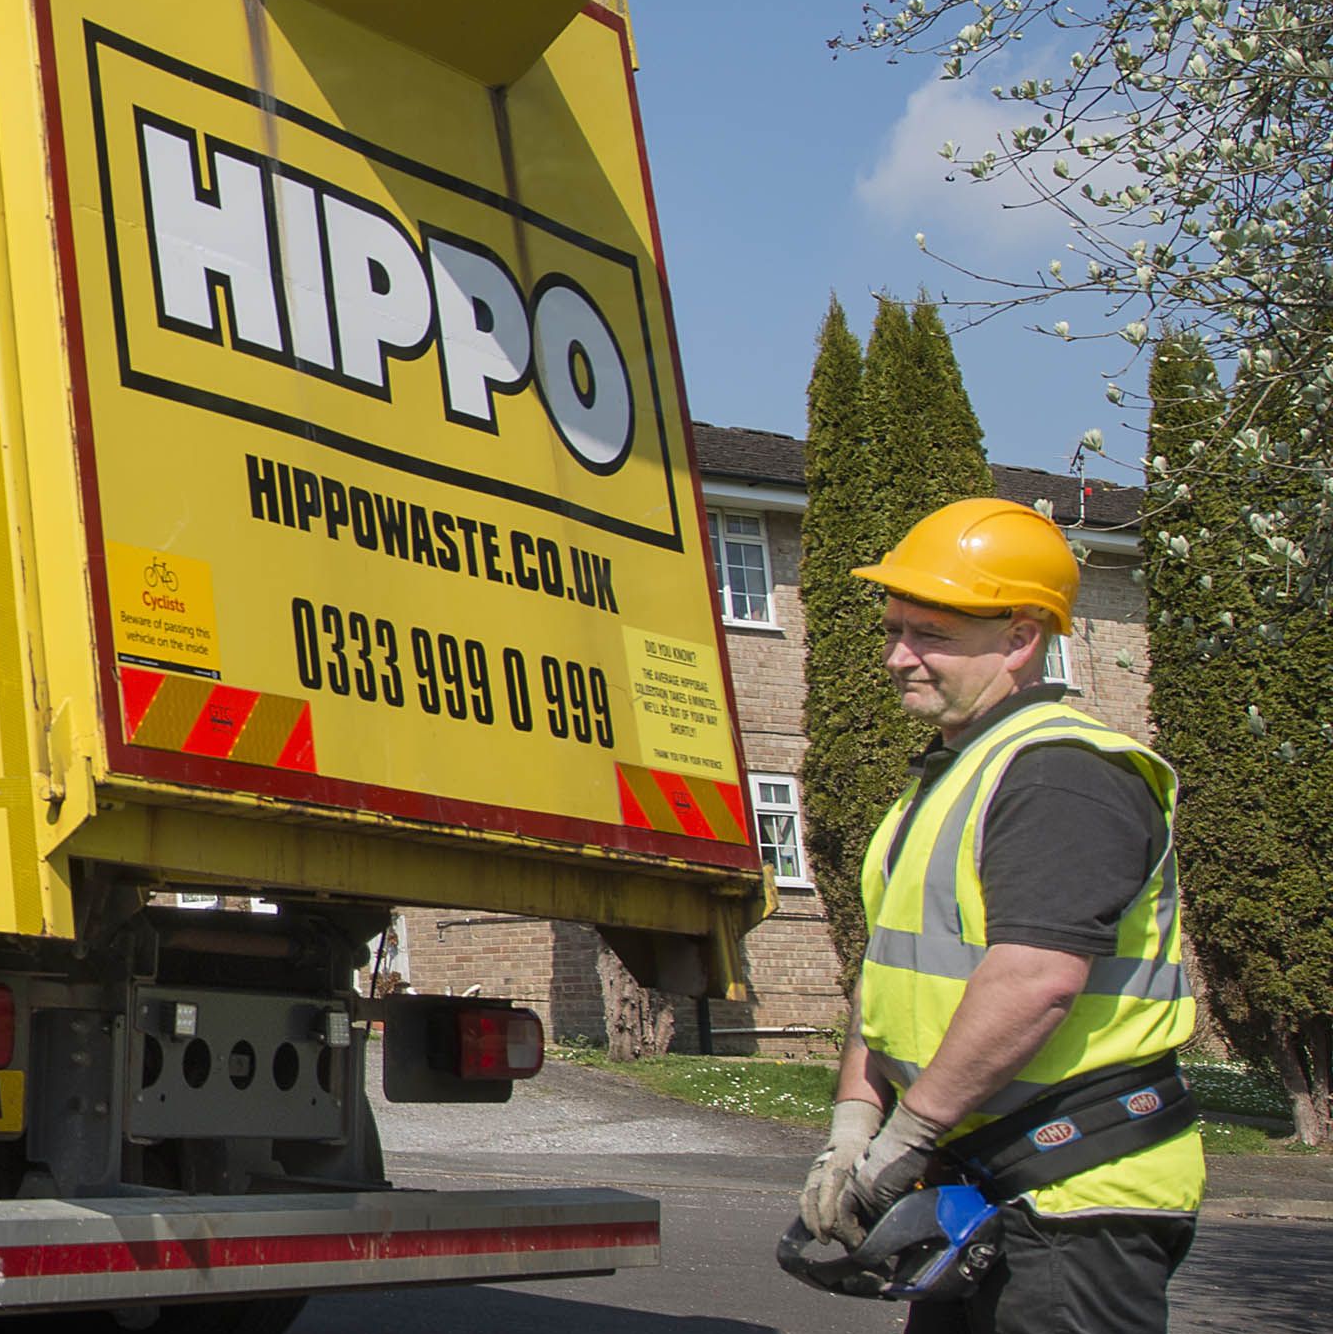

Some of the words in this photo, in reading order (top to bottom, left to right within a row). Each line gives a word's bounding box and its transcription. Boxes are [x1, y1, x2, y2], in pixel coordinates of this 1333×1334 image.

[133, 105, 636, 476] HIPPO
[245, 454, 620, 615] HIPPOWASTE.CO.UK
[142, 591, 185, 613] Cyclists
[120, 610, 151, 627] Beware
[153, 619, 162, 629] of
[164, 622, 195, 639] passing
[196, 626, 211, 640] this
[125, 630, 155, 645] vehicle
[157, 637, 168, 647] on
[170, 638, 184, 651] the
[644, 639, 656, 655] DID
[658, 642, 672, 658] YOU
[673, 647, 697, 664] KNOW?
[292, 597, 405, 707] 0333
[413, 621, 495, 727] 999
[502, 647, 531, 734] 0
[541, 656, 616, 749] 999
[642, 667, 654, 680] THE
[1037, 1123, 1072, 1144] HMF
